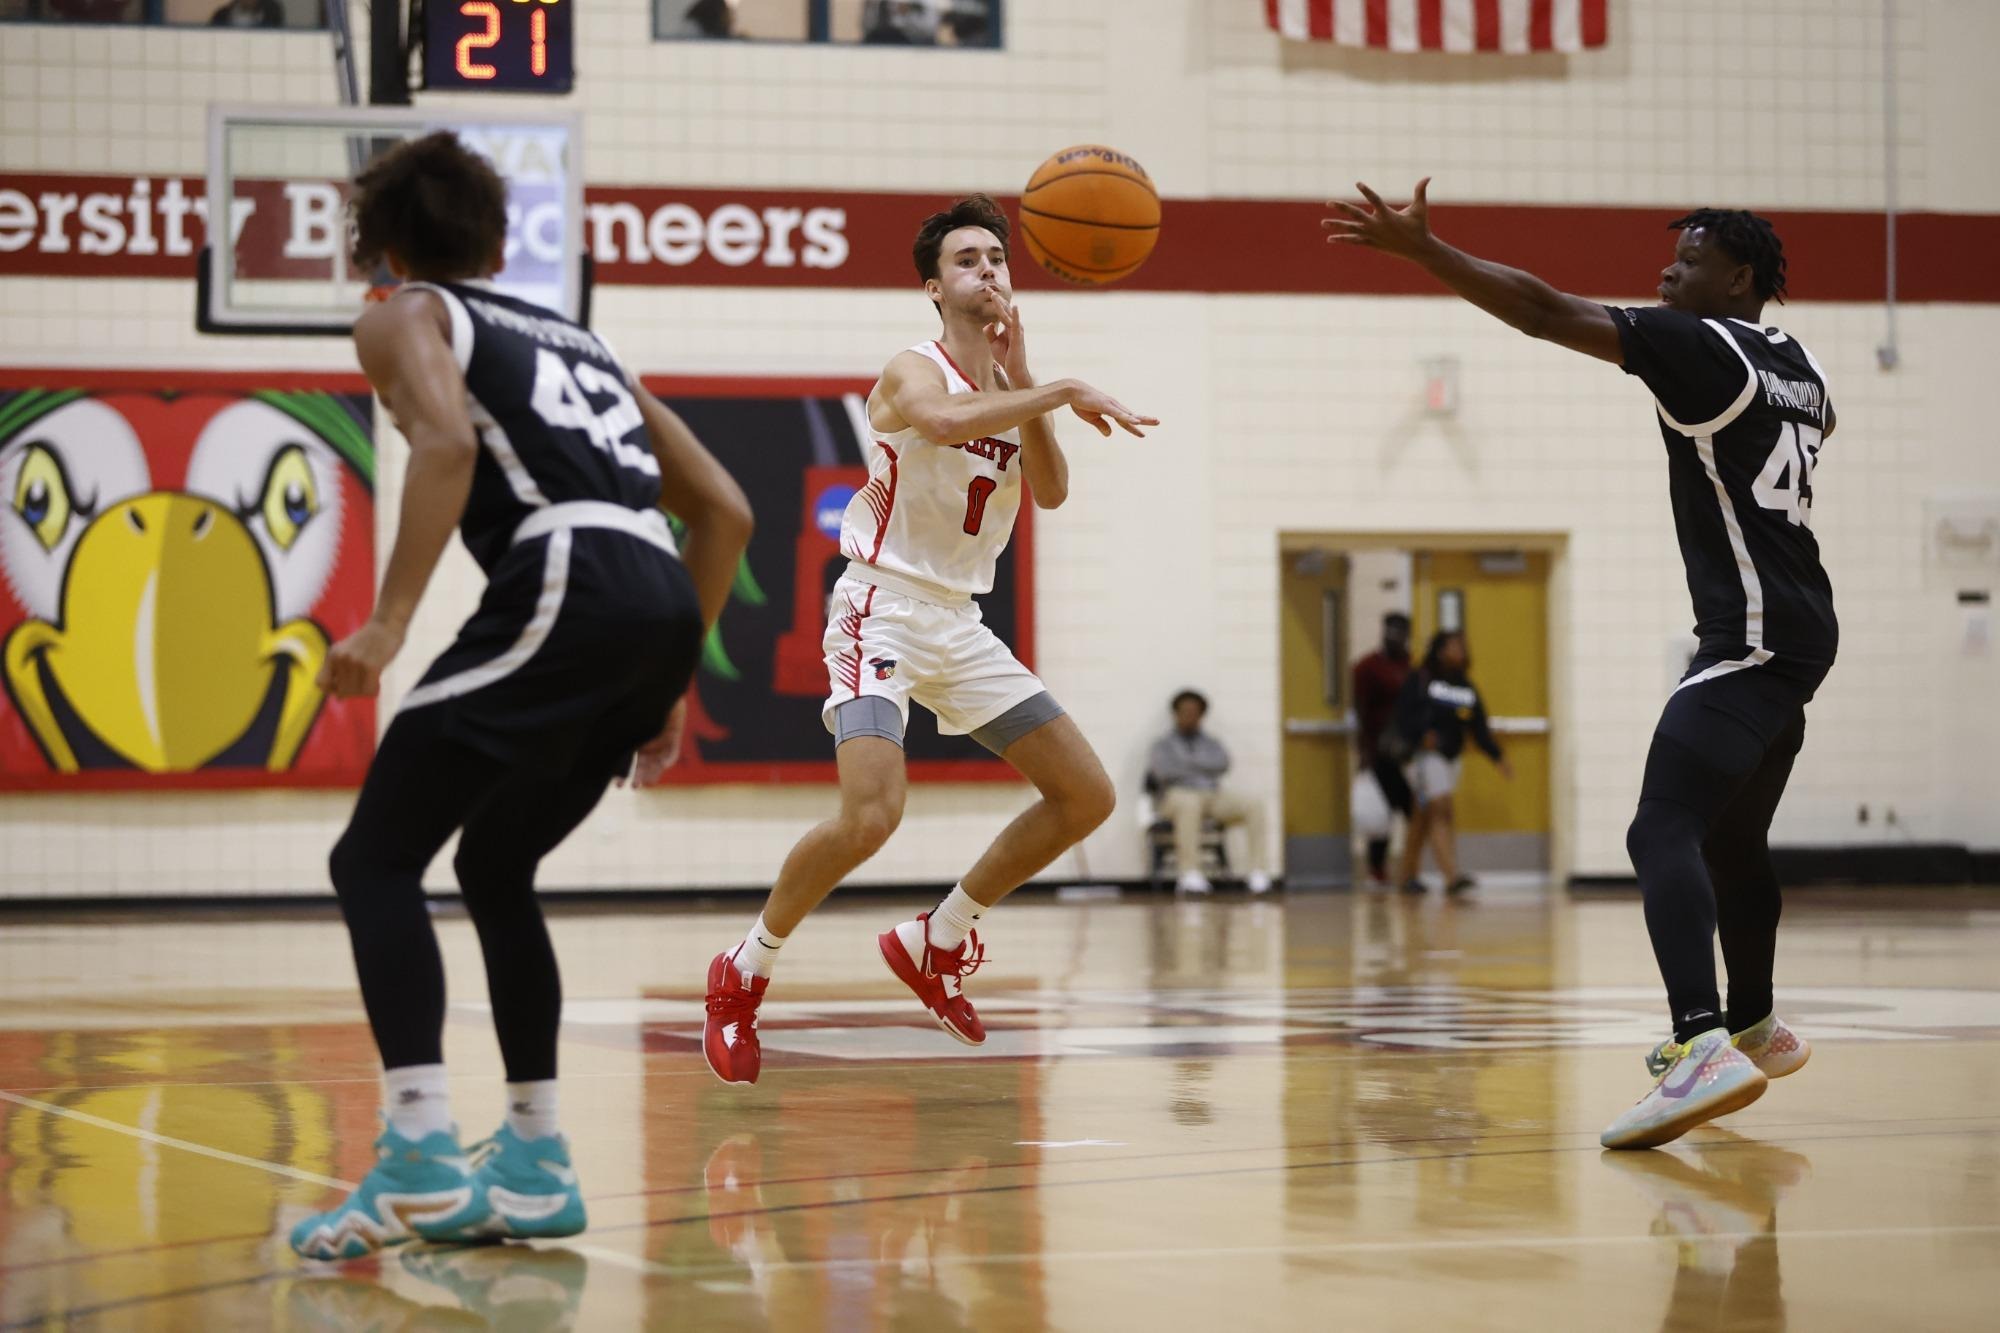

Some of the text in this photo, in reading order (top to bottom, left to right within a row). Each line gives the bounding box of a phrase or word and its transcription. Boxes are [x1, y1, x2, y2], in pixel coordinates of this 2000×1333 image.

[456, 1, 546, 79] 21
[530, 347, 661, 476] 42
[963, 475, 997, 536] 0
[1751, 421, 1823, 528] 45
